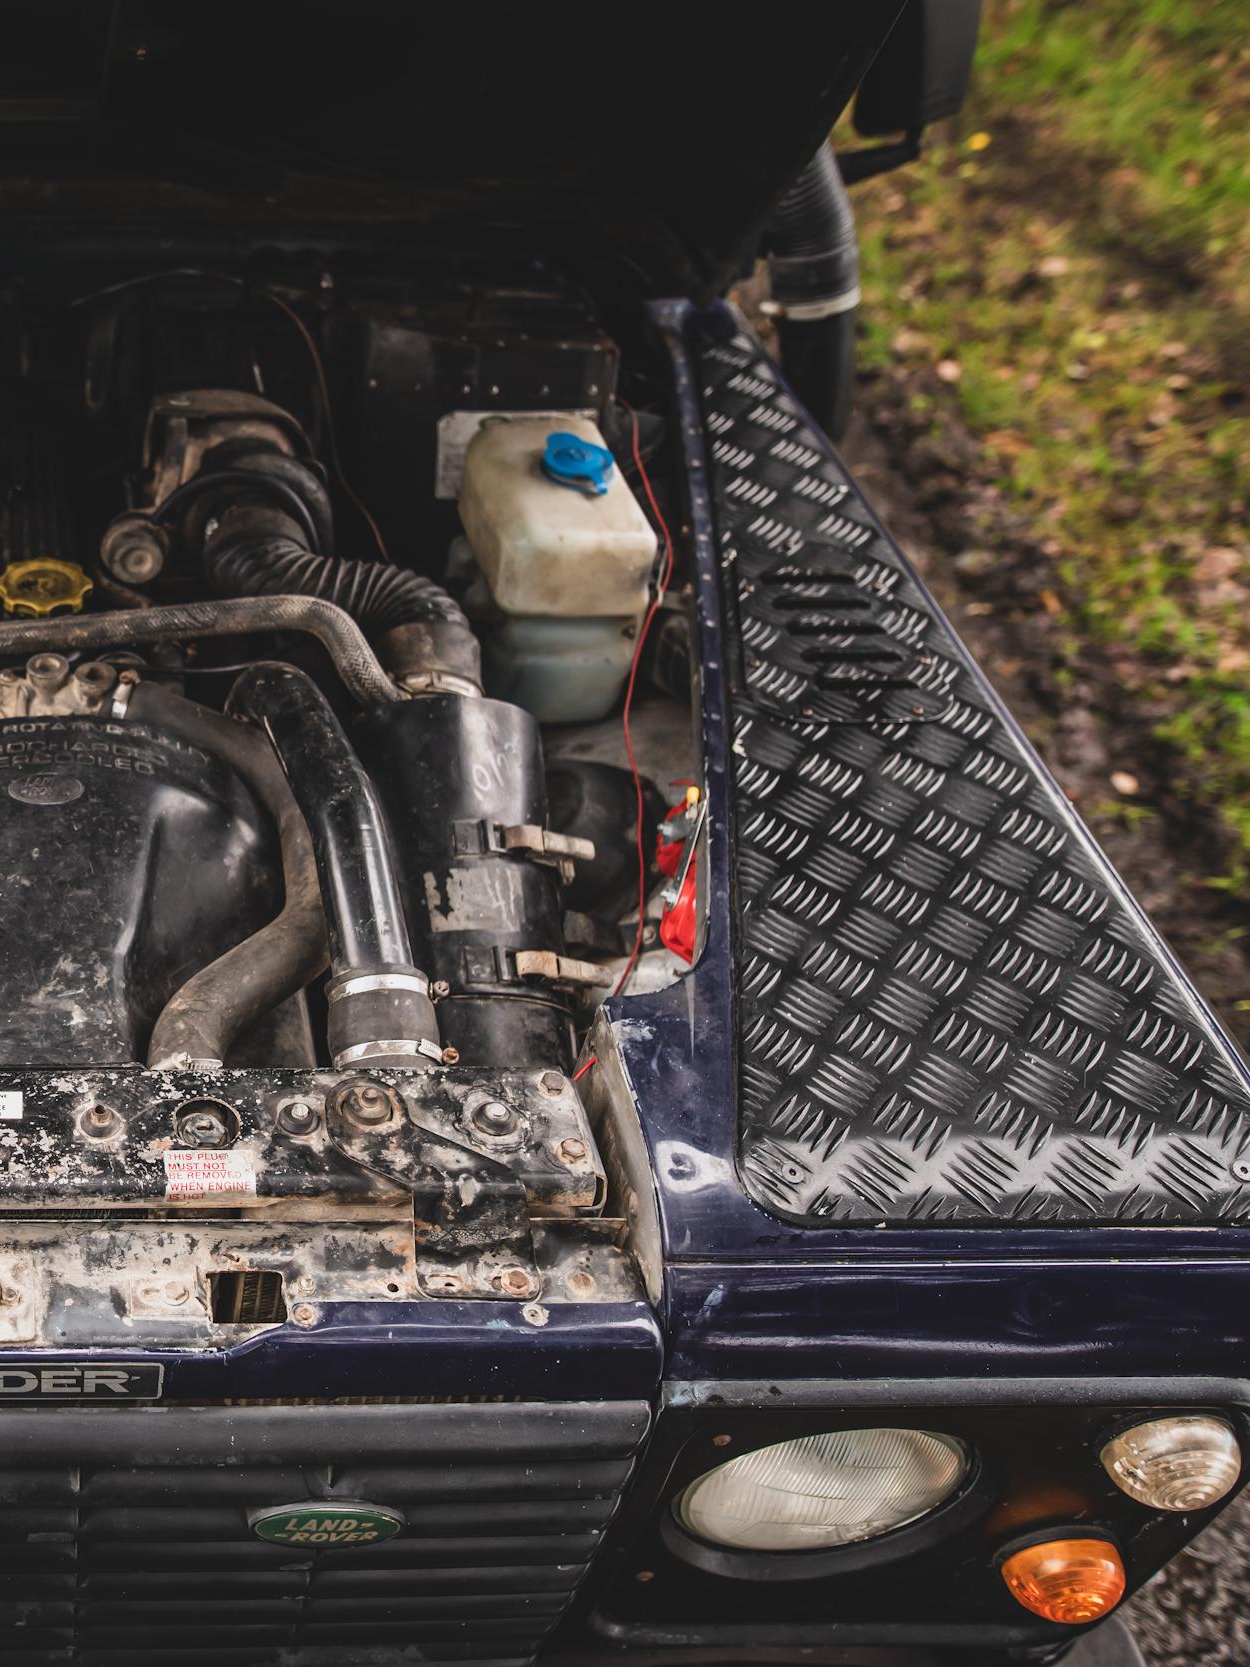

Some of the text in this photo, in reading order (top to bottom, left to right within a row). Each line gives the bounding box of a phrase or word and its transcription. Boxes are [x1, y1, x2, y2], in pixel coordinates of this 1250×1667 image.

[203, 1162, 227, 1170] NOT
[169, 1172, 243, 1180] BE REMOVED
[170, 1182, 252, 1191] WHEN ENGINE
